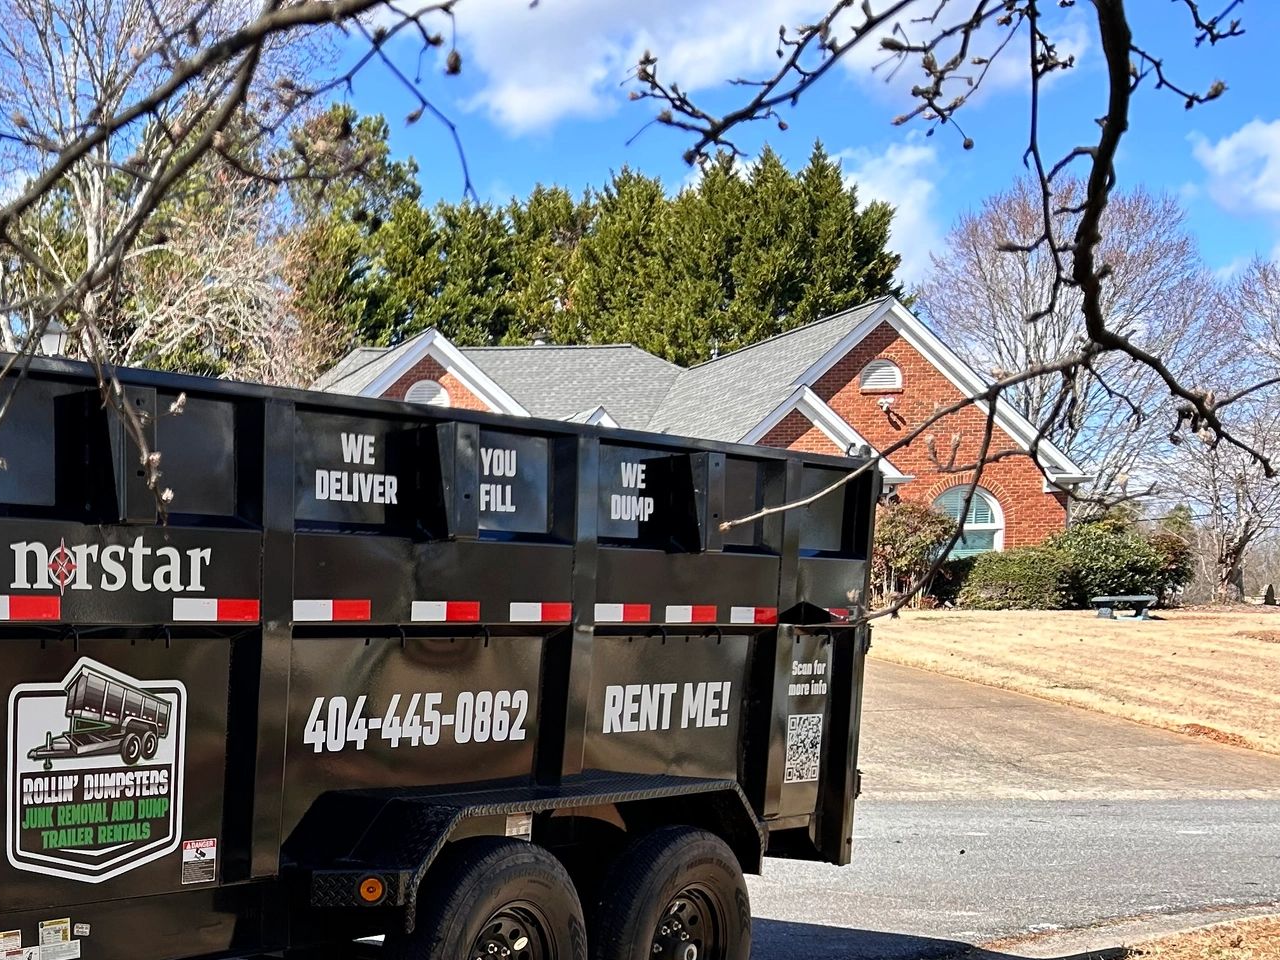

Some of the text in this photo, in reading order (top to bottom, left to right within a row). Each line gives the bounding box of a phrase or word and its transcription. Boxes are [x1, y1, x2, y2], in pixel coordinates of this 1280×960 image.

[340, 432, 375, 465] WE
[480, 447, 517, 477] YOU
[315, 469, 398, 505] DELIVER
[621, 462, 646, 489] WE
[479, 484, 516, 513] FILL
[610, 494, 654, 522] DUMP
[9, 535, 212, 593] norstar
[791, 659, 827, 676] Scan for
[788, 680, 827, 696] more info
[303, 689, 529, 753] 404-445-0862
[602, 681, 732, 734] RENT ME!
[22, 769, 169, 806] ROLLIN' DUMPSTERS
[22, 797, 169, 830] JUNK REMOVAL AND DUMP
[41, 821, 151, 850] TRAILER RENTALS
[191, 840, 214, 849] DANGER
